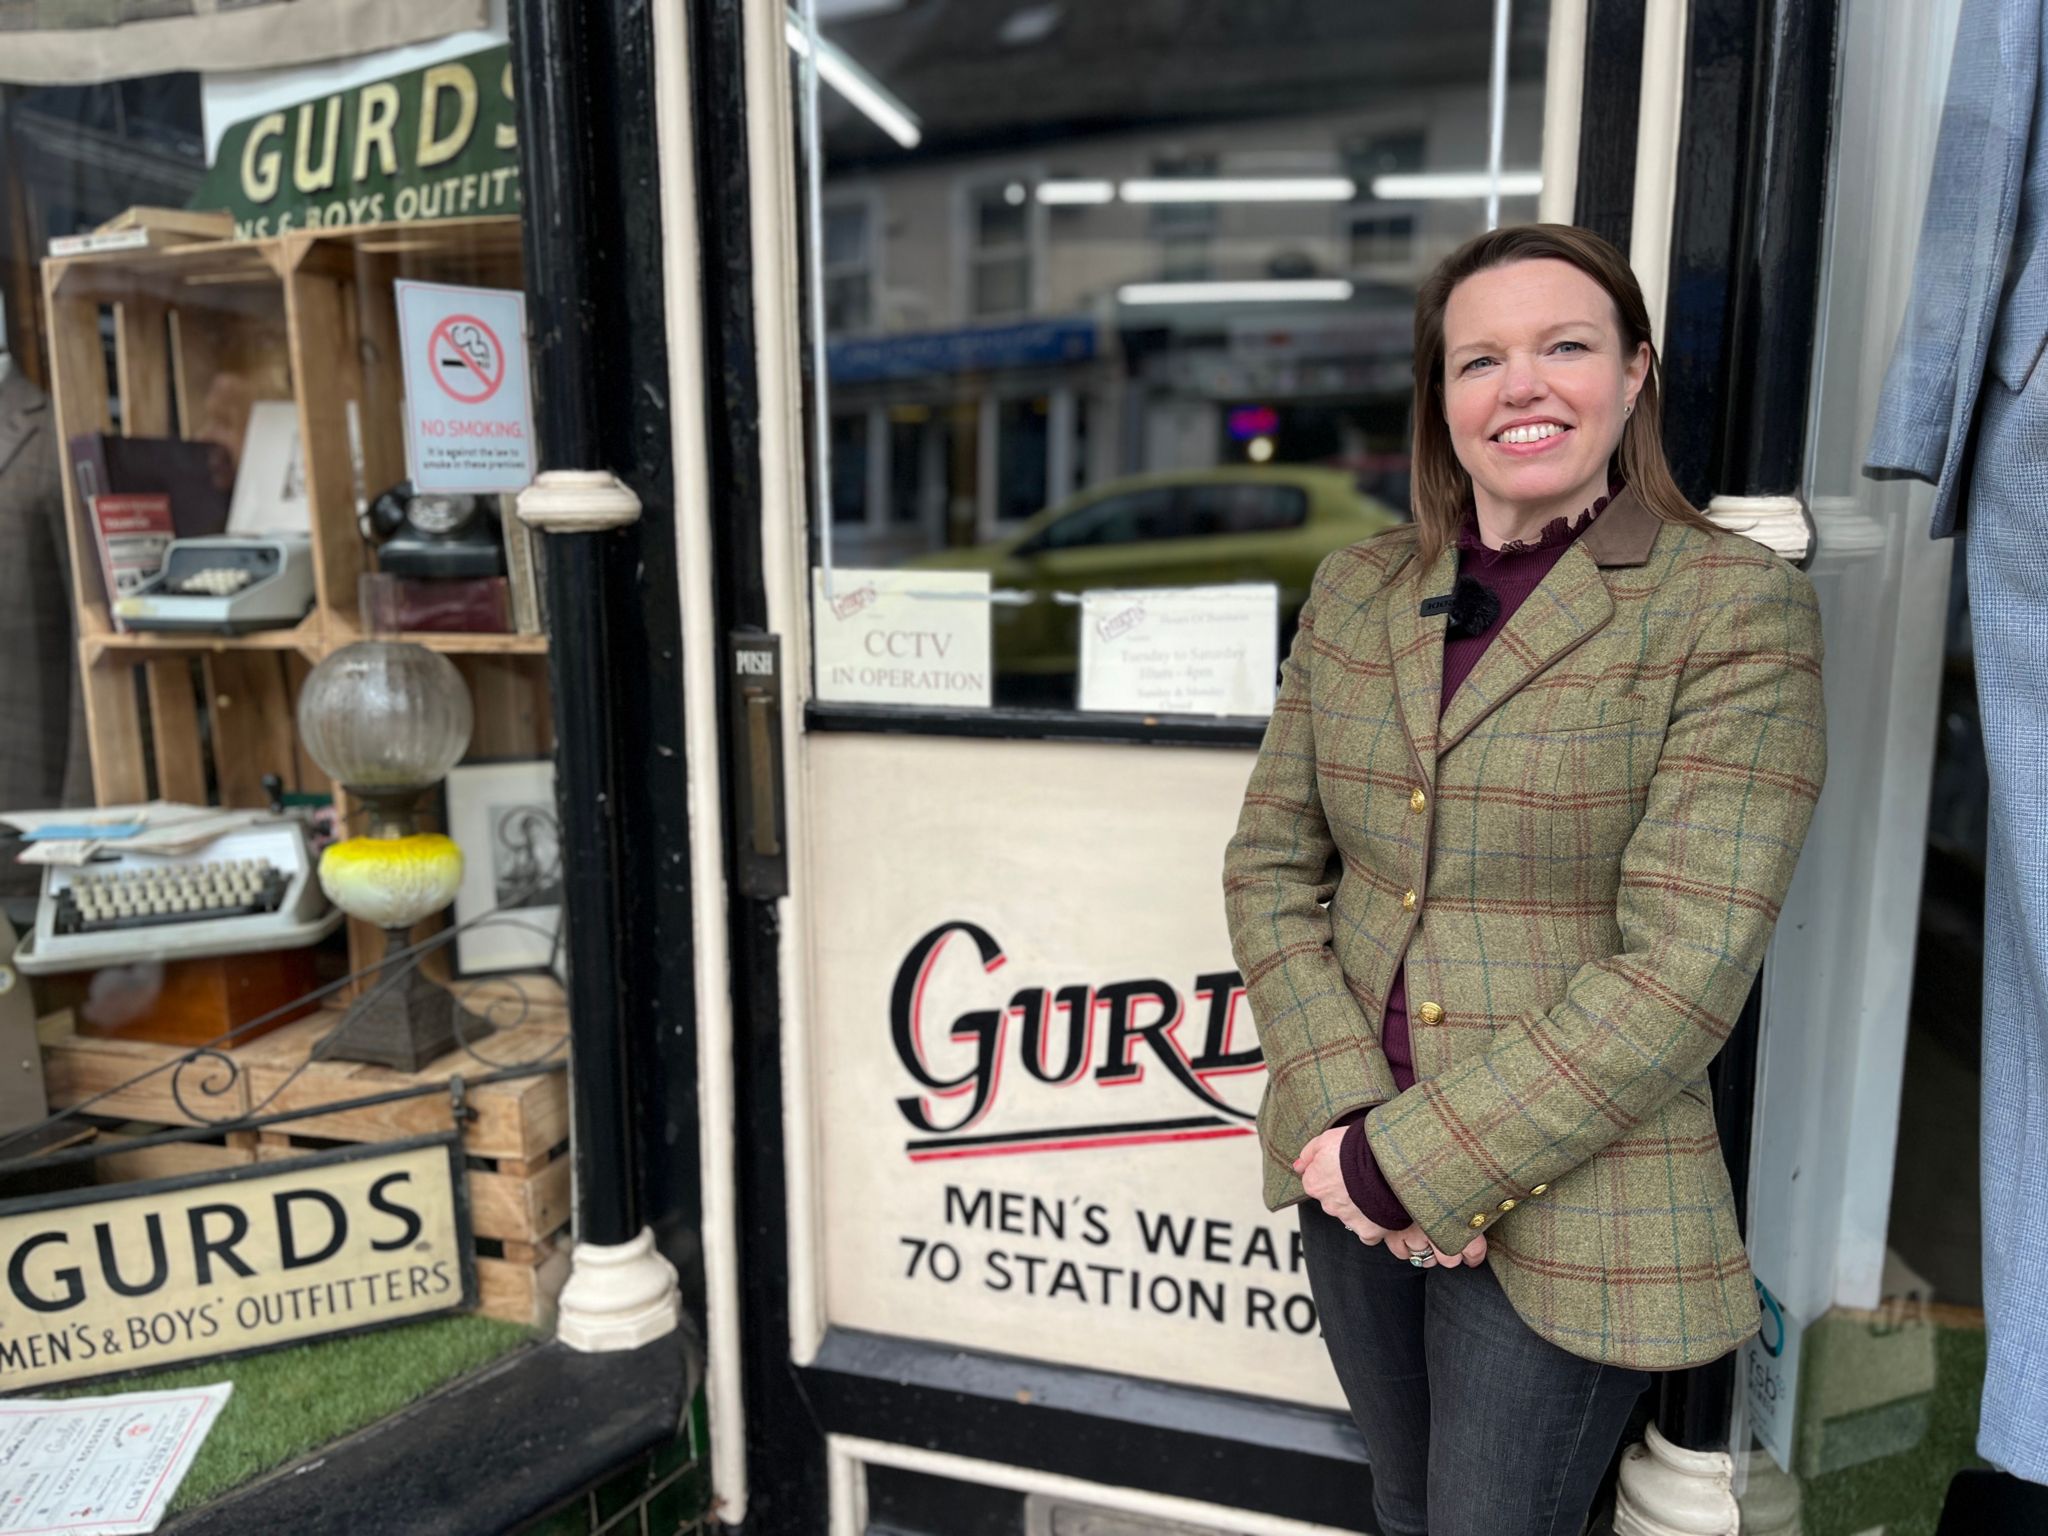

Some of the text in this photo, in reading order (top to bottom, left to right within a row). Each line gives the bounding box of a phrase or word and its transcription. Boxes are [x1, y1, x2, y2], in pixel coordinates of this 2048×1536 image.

[305, 194, 384, 229] BOYS
[394, 168, 520, 220] OUTFIT
[422, 420, 445, 438] NO
[737, 651, 773, 675] PUSH
[864, 629, 953, 660] CCTV
[832, 667, 984, 692] IN OPERATION
[889, 920, 1270, 1134] GURD
[7, 1171, 423, 1312] GURDS
[943, 1185, 1111, 1246] MEN'S
[102, 1328, 123, 1355] &
[236, 1259, 453, 1330] OUTFITTERS
[901, 1238, 1324, 1338] 70 STATION RO
